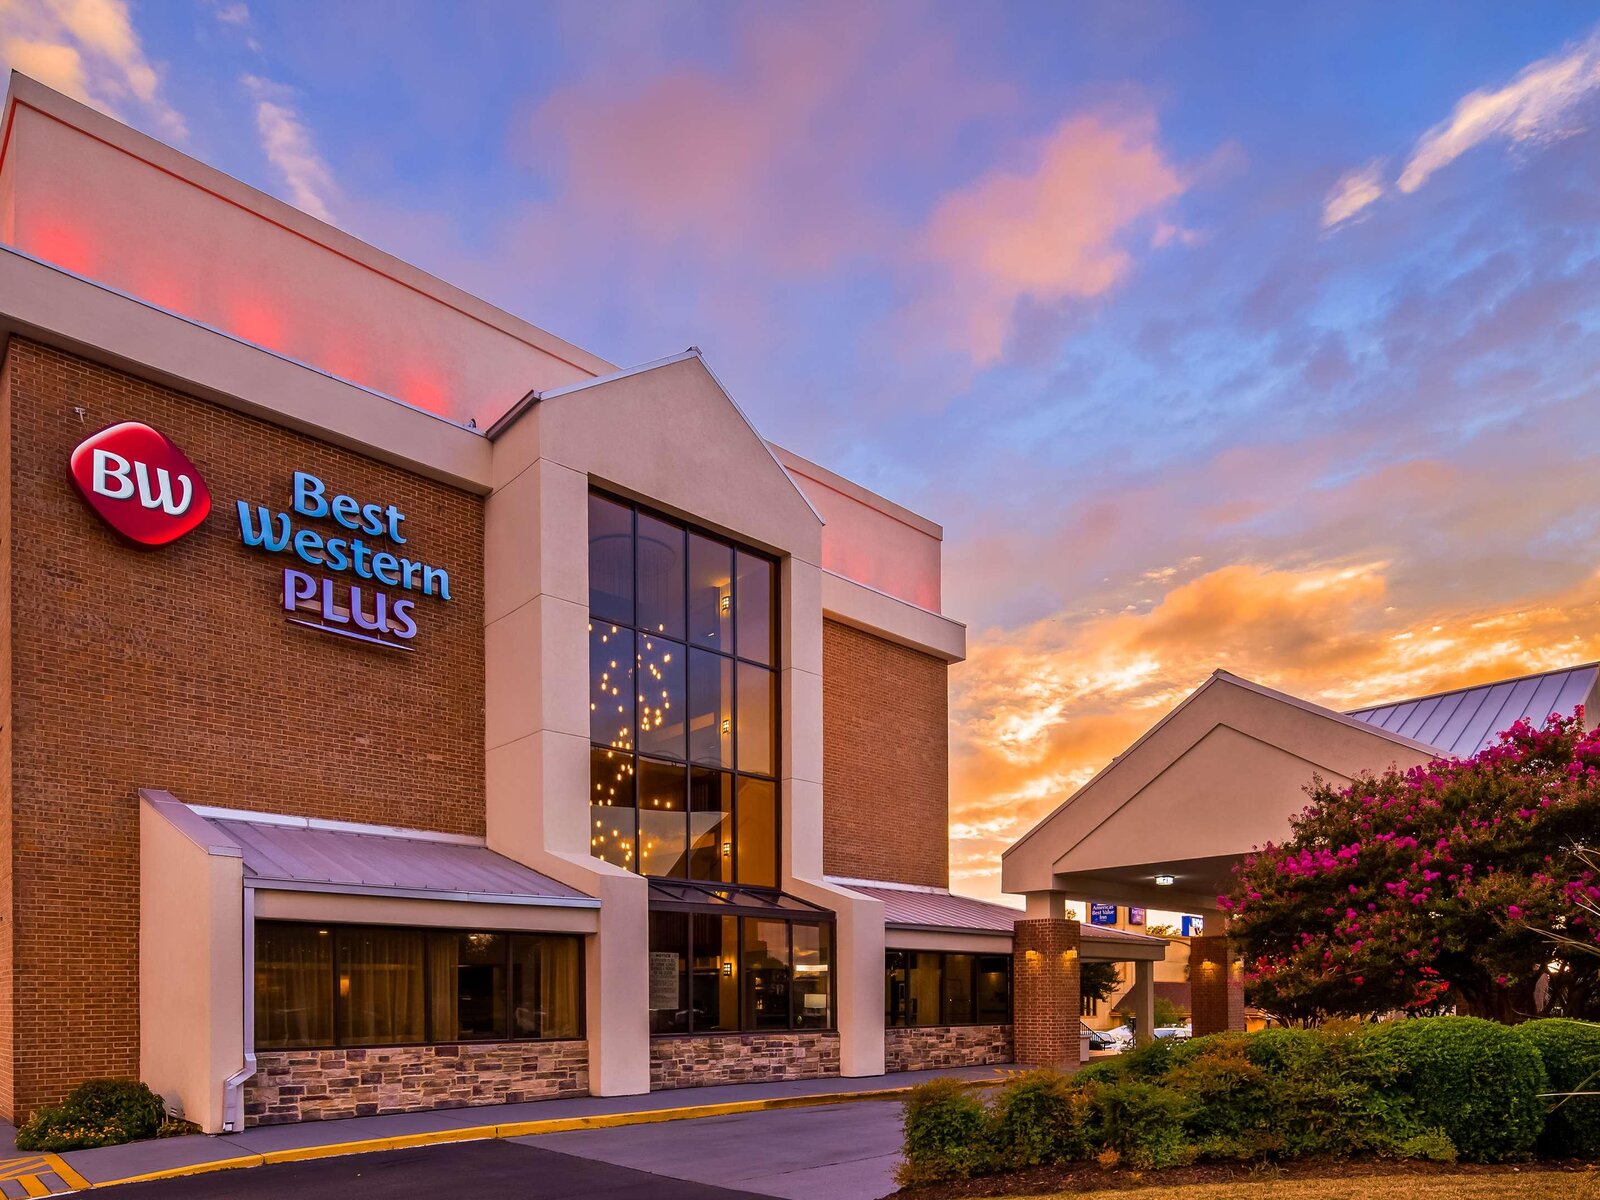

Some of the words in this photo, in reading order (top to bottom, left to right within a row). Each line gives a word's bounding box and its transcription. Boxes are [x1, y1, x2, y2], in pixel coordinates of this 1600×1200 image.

[92, 448, 193, 516] BW
[292, 470, 407, 544] Best
[236, 499, 452, 600] Western
[283, 567, 418, 639] PLUS
